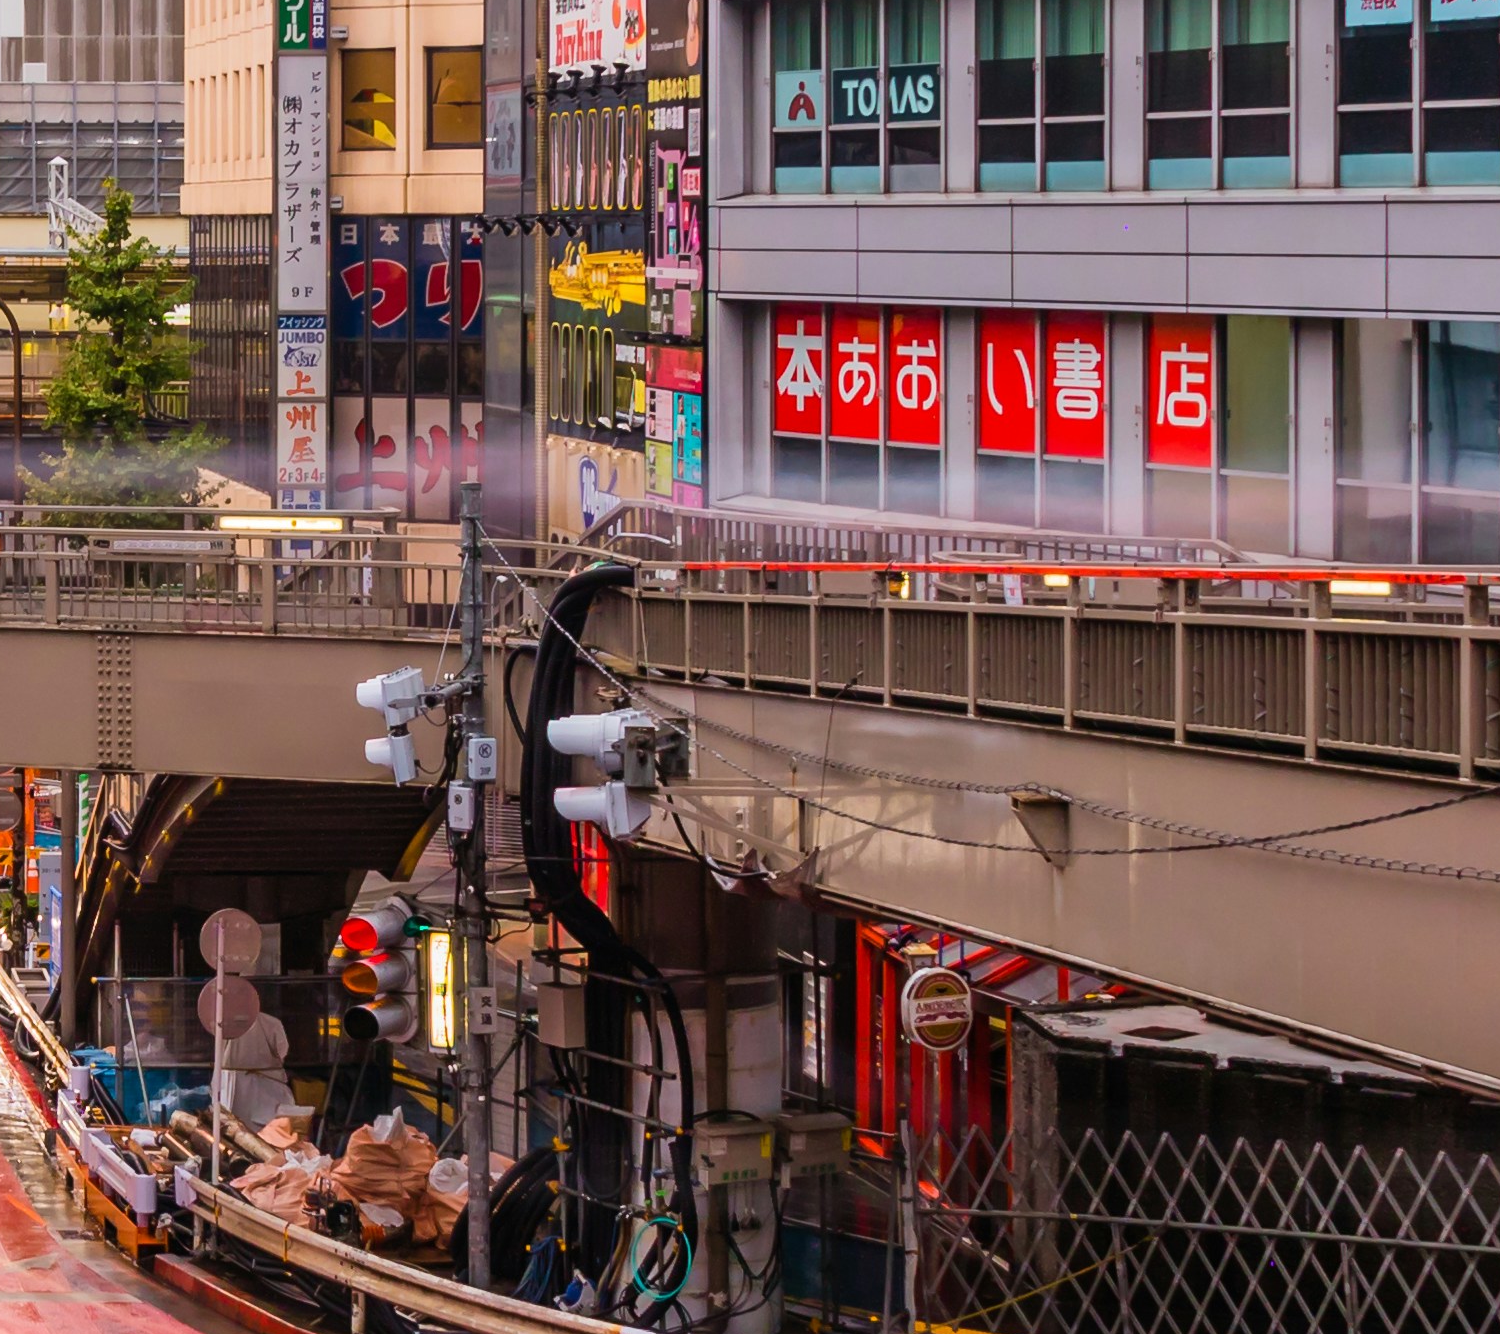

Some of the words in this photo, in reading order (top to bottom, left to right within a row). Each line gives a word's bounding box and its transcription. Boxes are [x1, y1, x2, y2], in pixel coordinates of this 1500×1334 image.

[310, 70, 322, 173] ビル・マンション
[842, 74, 934, 117] TOMAS
[310, 186, 322, 246] 仲介・管理
[279, 331, 325, 344] JUMBO
[286, 369, 317, 464] 上州屋
